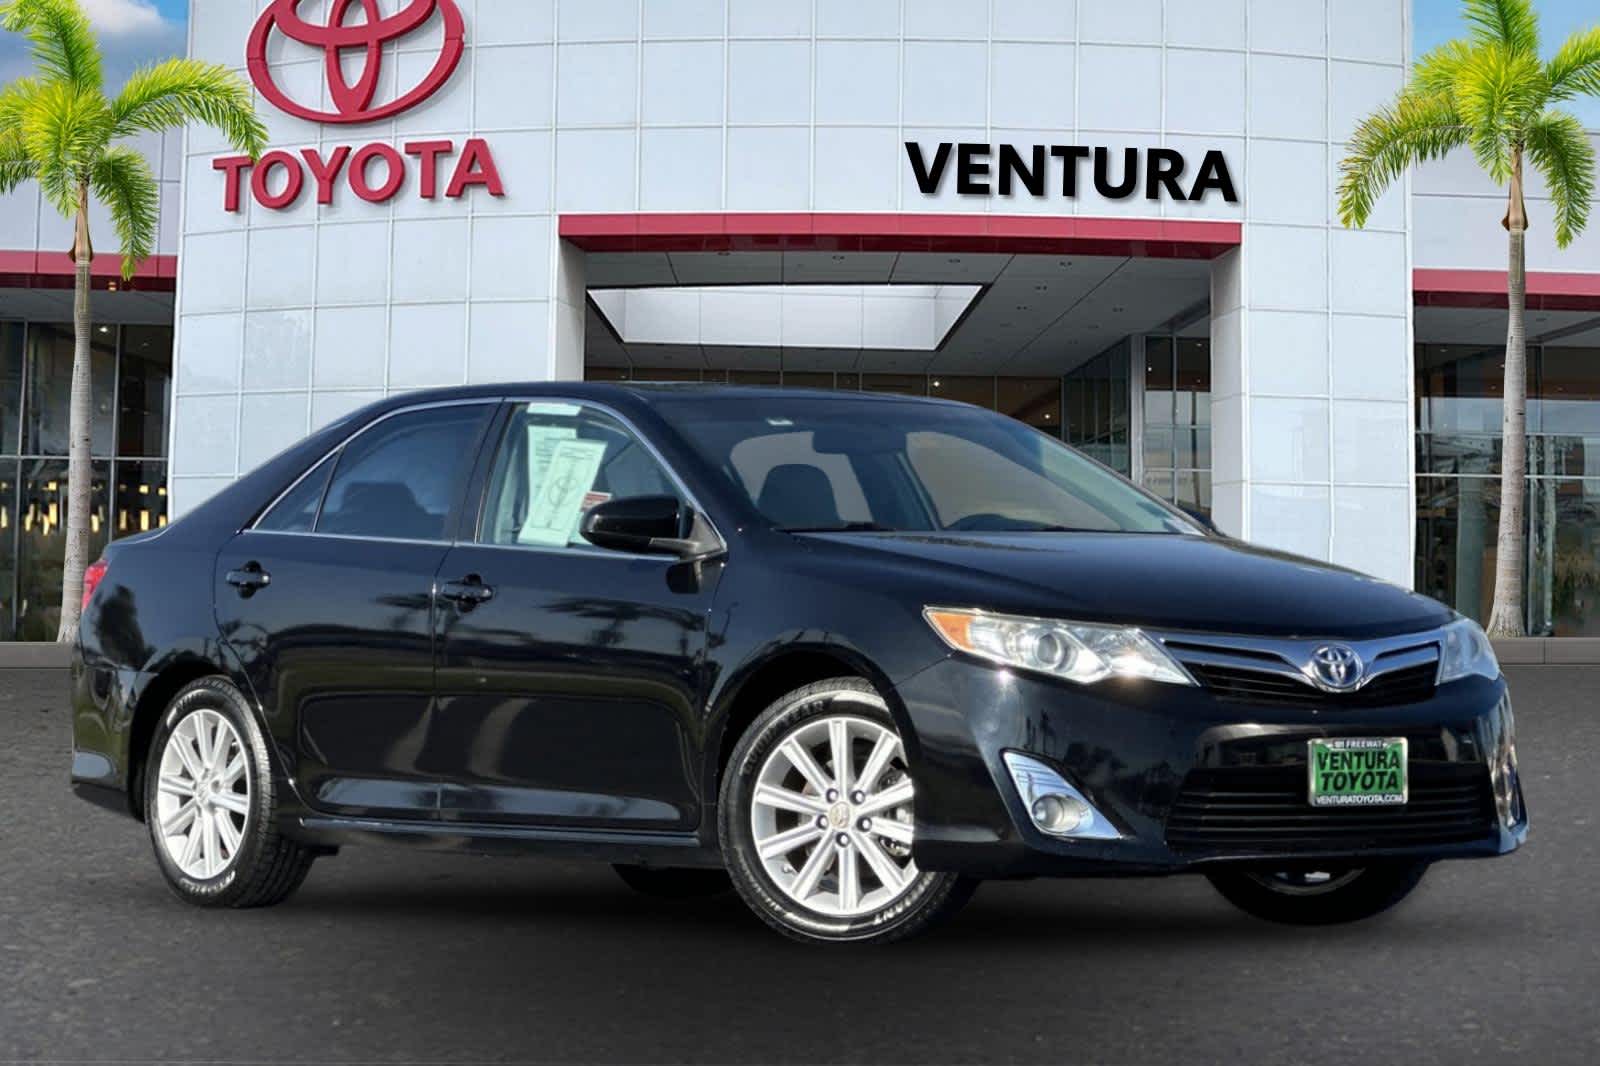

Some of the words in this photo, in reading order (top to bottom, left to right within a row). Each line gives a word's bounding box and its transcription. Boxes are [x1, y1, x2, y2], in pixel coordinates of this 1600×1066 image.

[212, 138, 505, 212] TOYOTA
[904, 142, 1238, 203] VENTURA
[1317, 751, 1400, 771] VENTURA
[1320, 771, 1399, 791] TOYOTA
[1315, 794, 1403, 805] VENTURATOYOTA.COM
